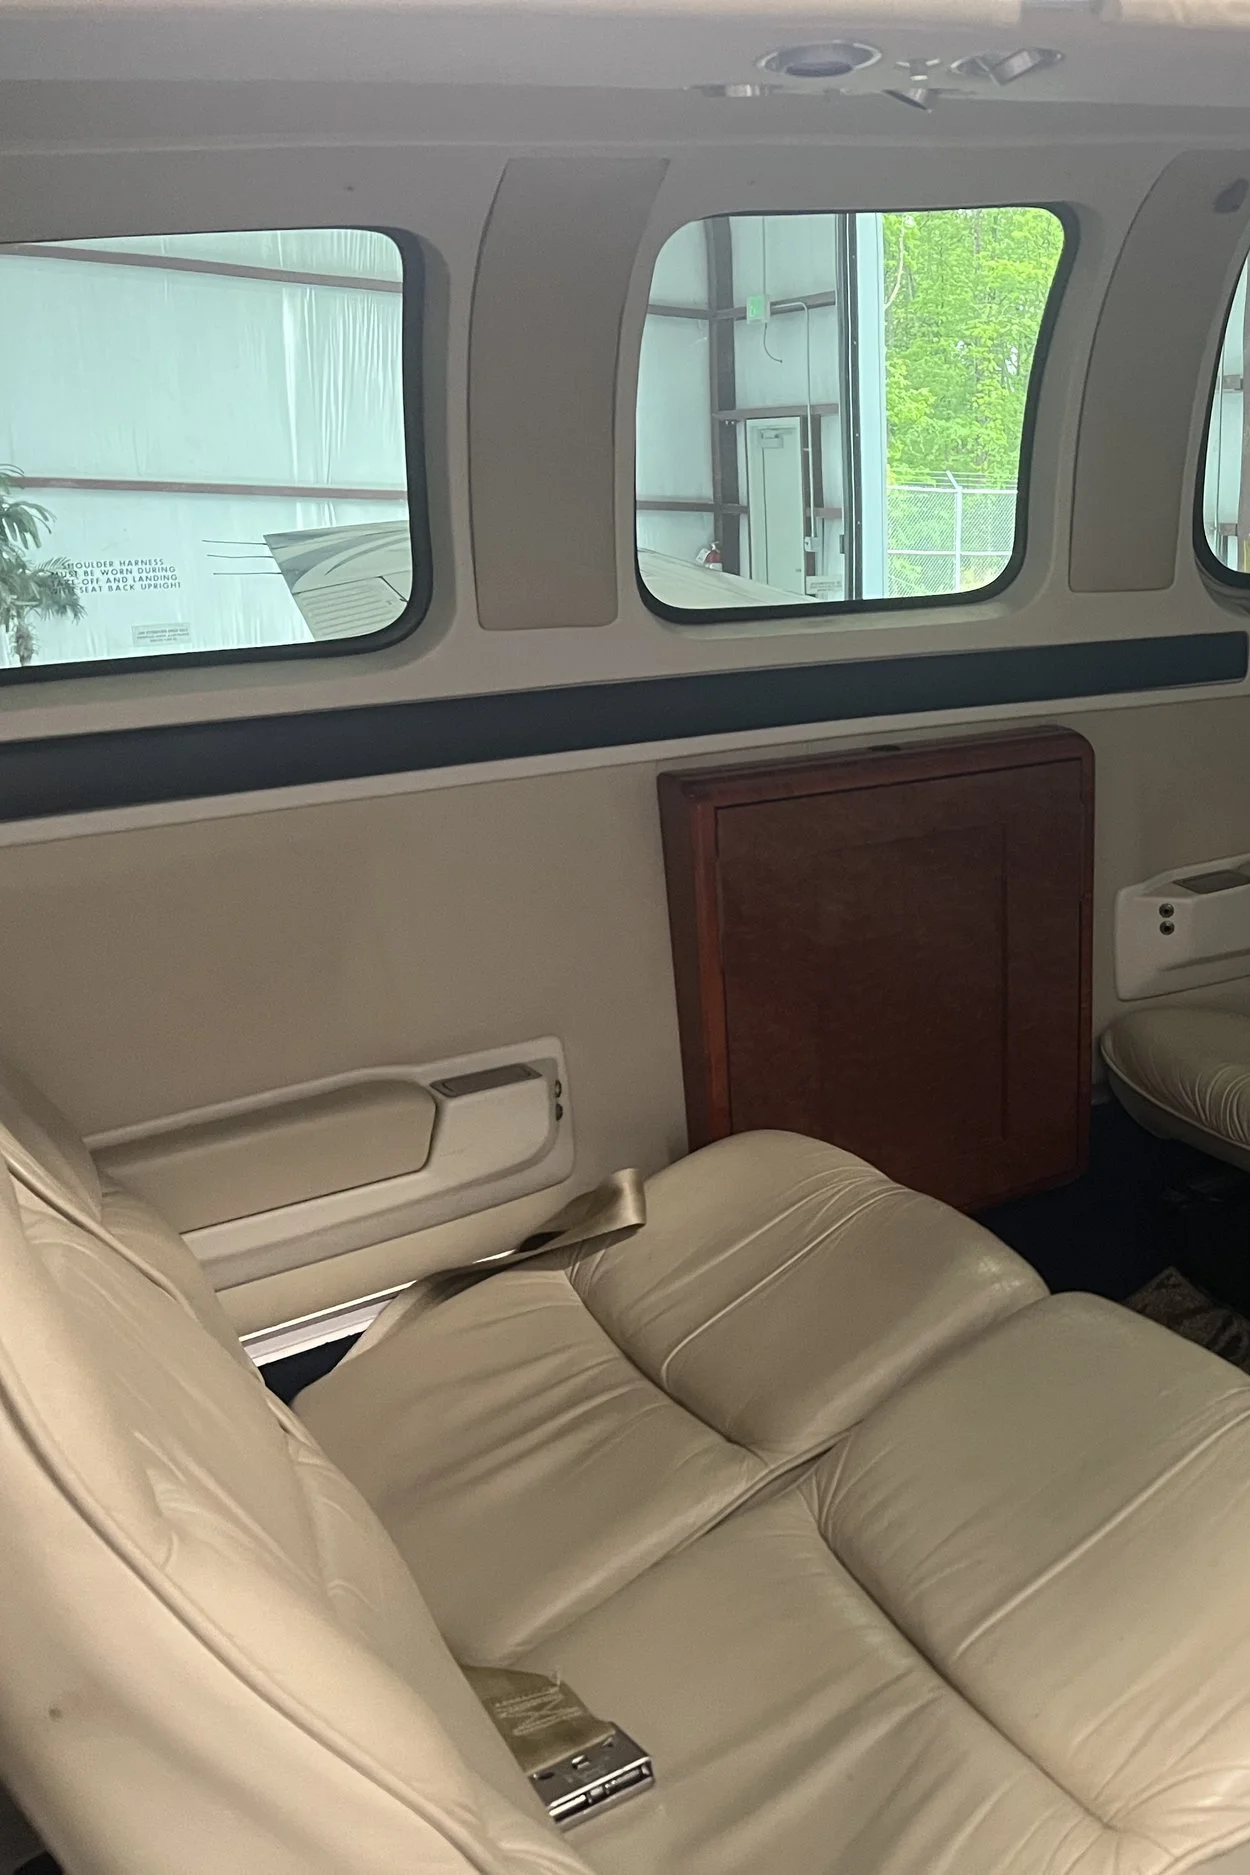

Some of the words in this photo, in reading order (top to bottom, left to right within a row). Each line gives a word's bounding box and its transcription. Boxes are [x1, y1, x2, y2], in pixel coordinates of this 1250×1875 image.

[119, 558, 164, 567] HARNESS
[83, 569, 95, 577] BE
[100, 568, 133, 576] WORN
[137, 566, 176, 575] DURING
[81, 577, 99, 586] OFF
[105, 576, 128, 584] AND
[132, 574, 178, 583] LANDING
[79, 585, 102, 594] SEAT
[107, 584, 136, 592] BACK
[140, 581, 181, 591] UPRIGHT
